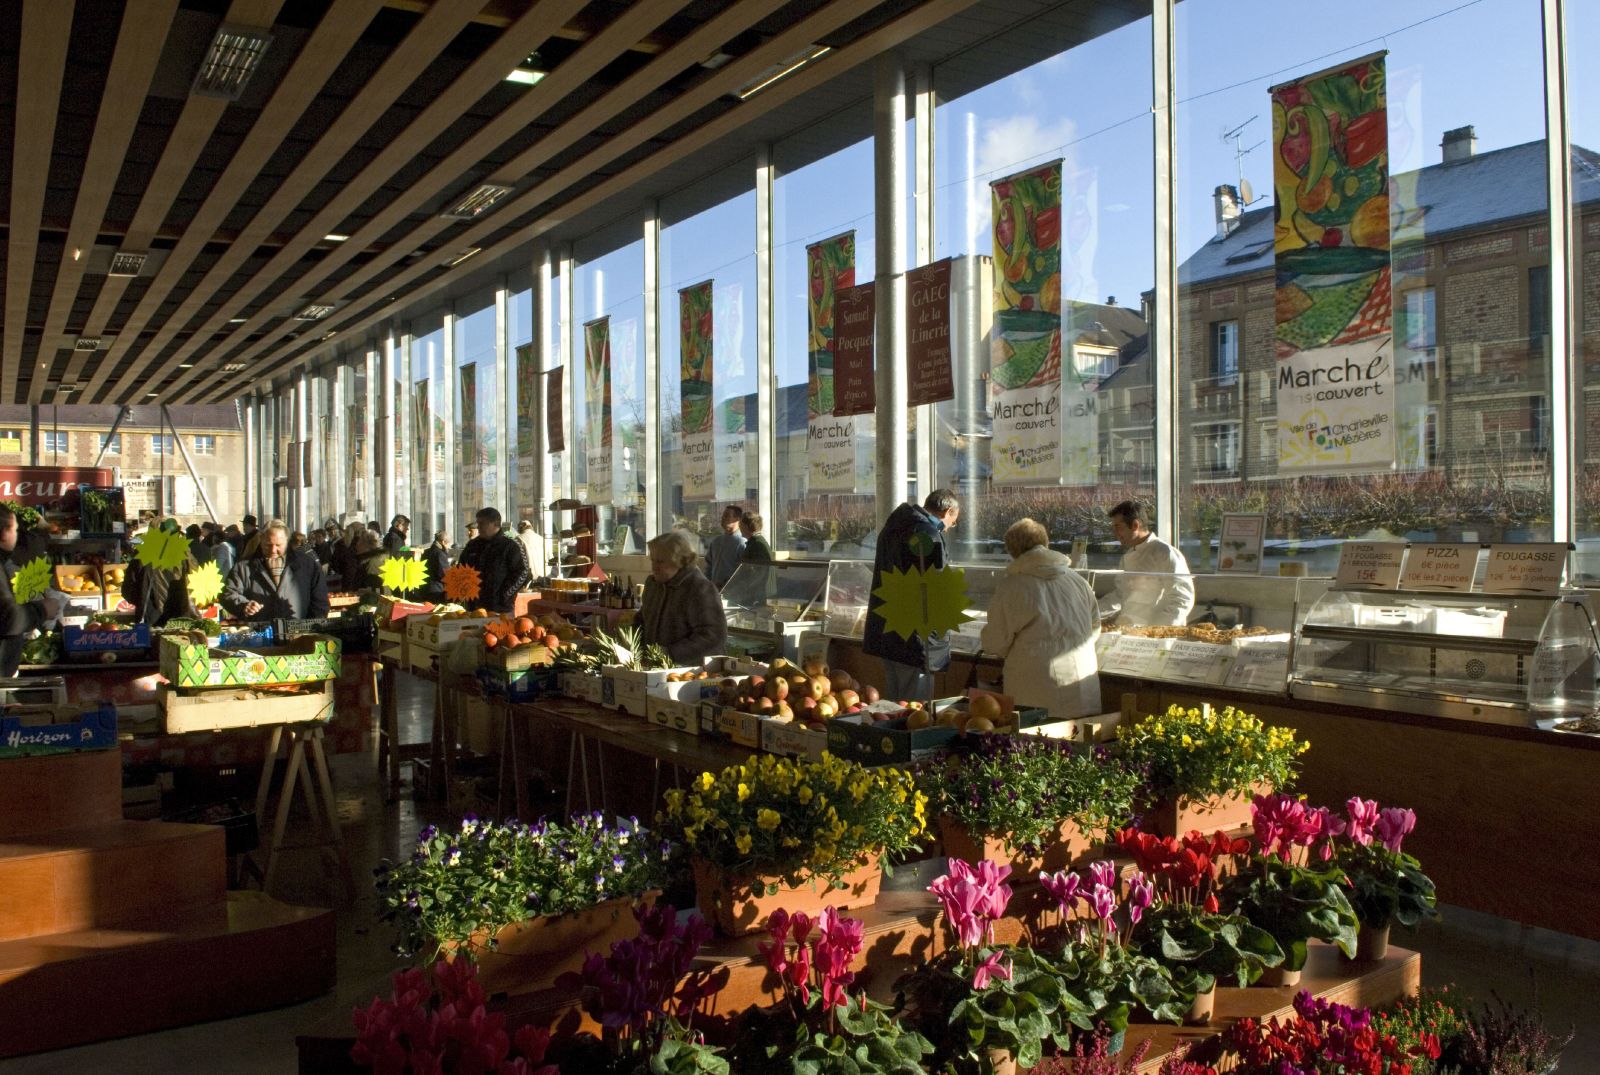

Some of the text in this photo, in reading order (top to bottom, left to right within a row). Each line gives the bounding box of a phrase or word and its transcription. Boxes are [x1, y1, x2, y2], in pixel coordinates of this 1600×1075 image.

[912, 283, 947, 307] GAEC
[843, 305, 869, 325] Samuel
[920, 307, 941, 324] de la
[912, 323, 949, 344] Linerie
[1278, 337, 1392, 390] Marché
[1316, 381, 1384, 401] couvert
[1015, 415, 1056, 430] couvert
[1332, 413, 1388, 436] Charleville
[823, 439, 852, 448] couvert
[1334, 429, 1381, 448] Mézières
[1427, 547, 1459, 558] PIZZA
[1496, 551, 1556, 562] FOUGASSE
[1356, 569, 1377, 580] 15€
[8, 731, 71, 748] Horizon
